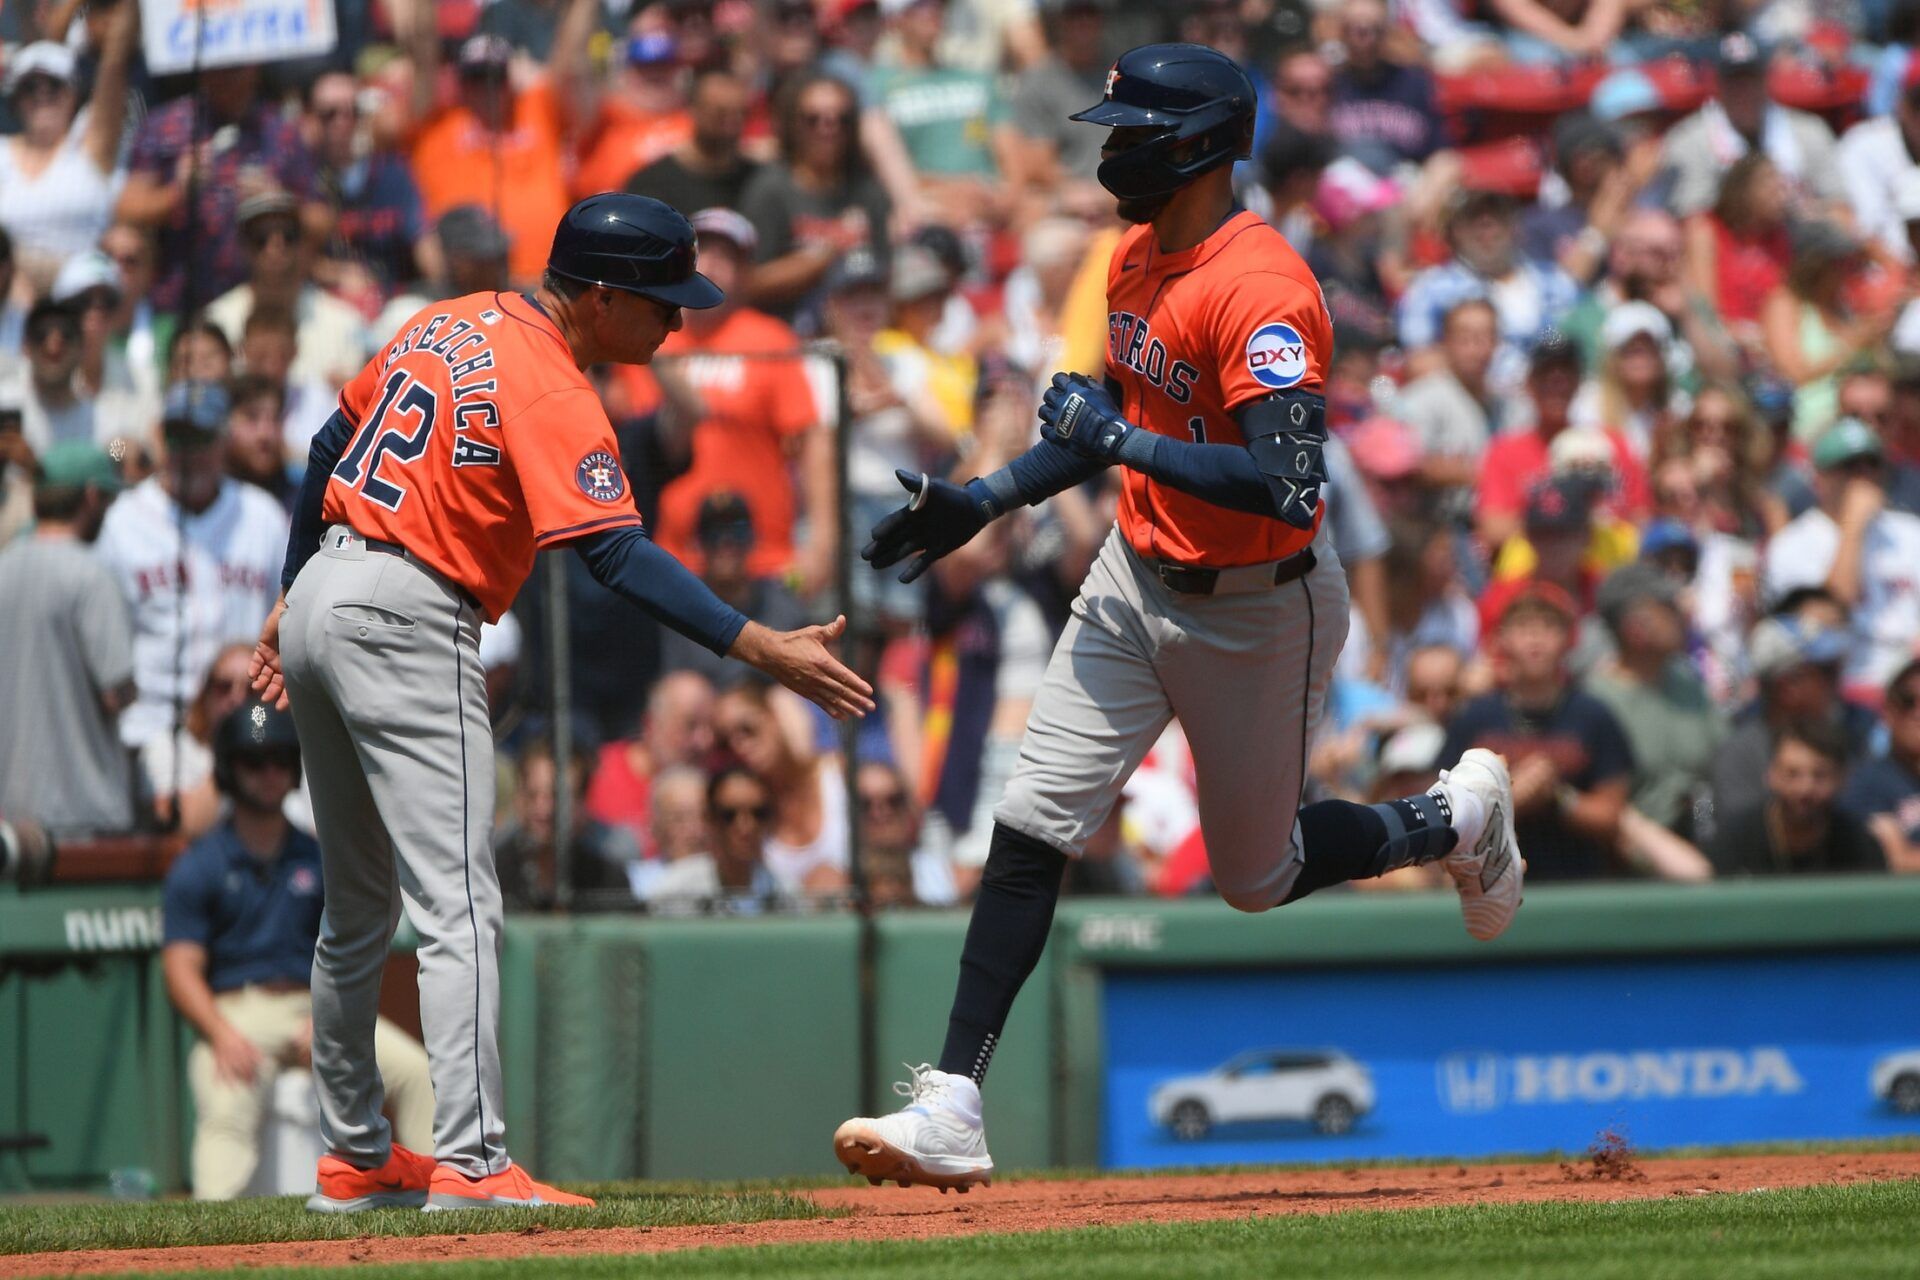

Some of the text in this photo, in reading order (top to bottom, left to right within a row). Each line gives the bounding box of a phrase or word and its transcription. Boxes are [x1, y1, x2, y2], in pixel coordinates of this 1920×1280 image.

[1248, 346, 1303, 368] OXY
[330, 367, 438, 513] 12
[580, 453, 617, 470] HOUSTON
[1513, 1045, 1804, 1104] HONDA
